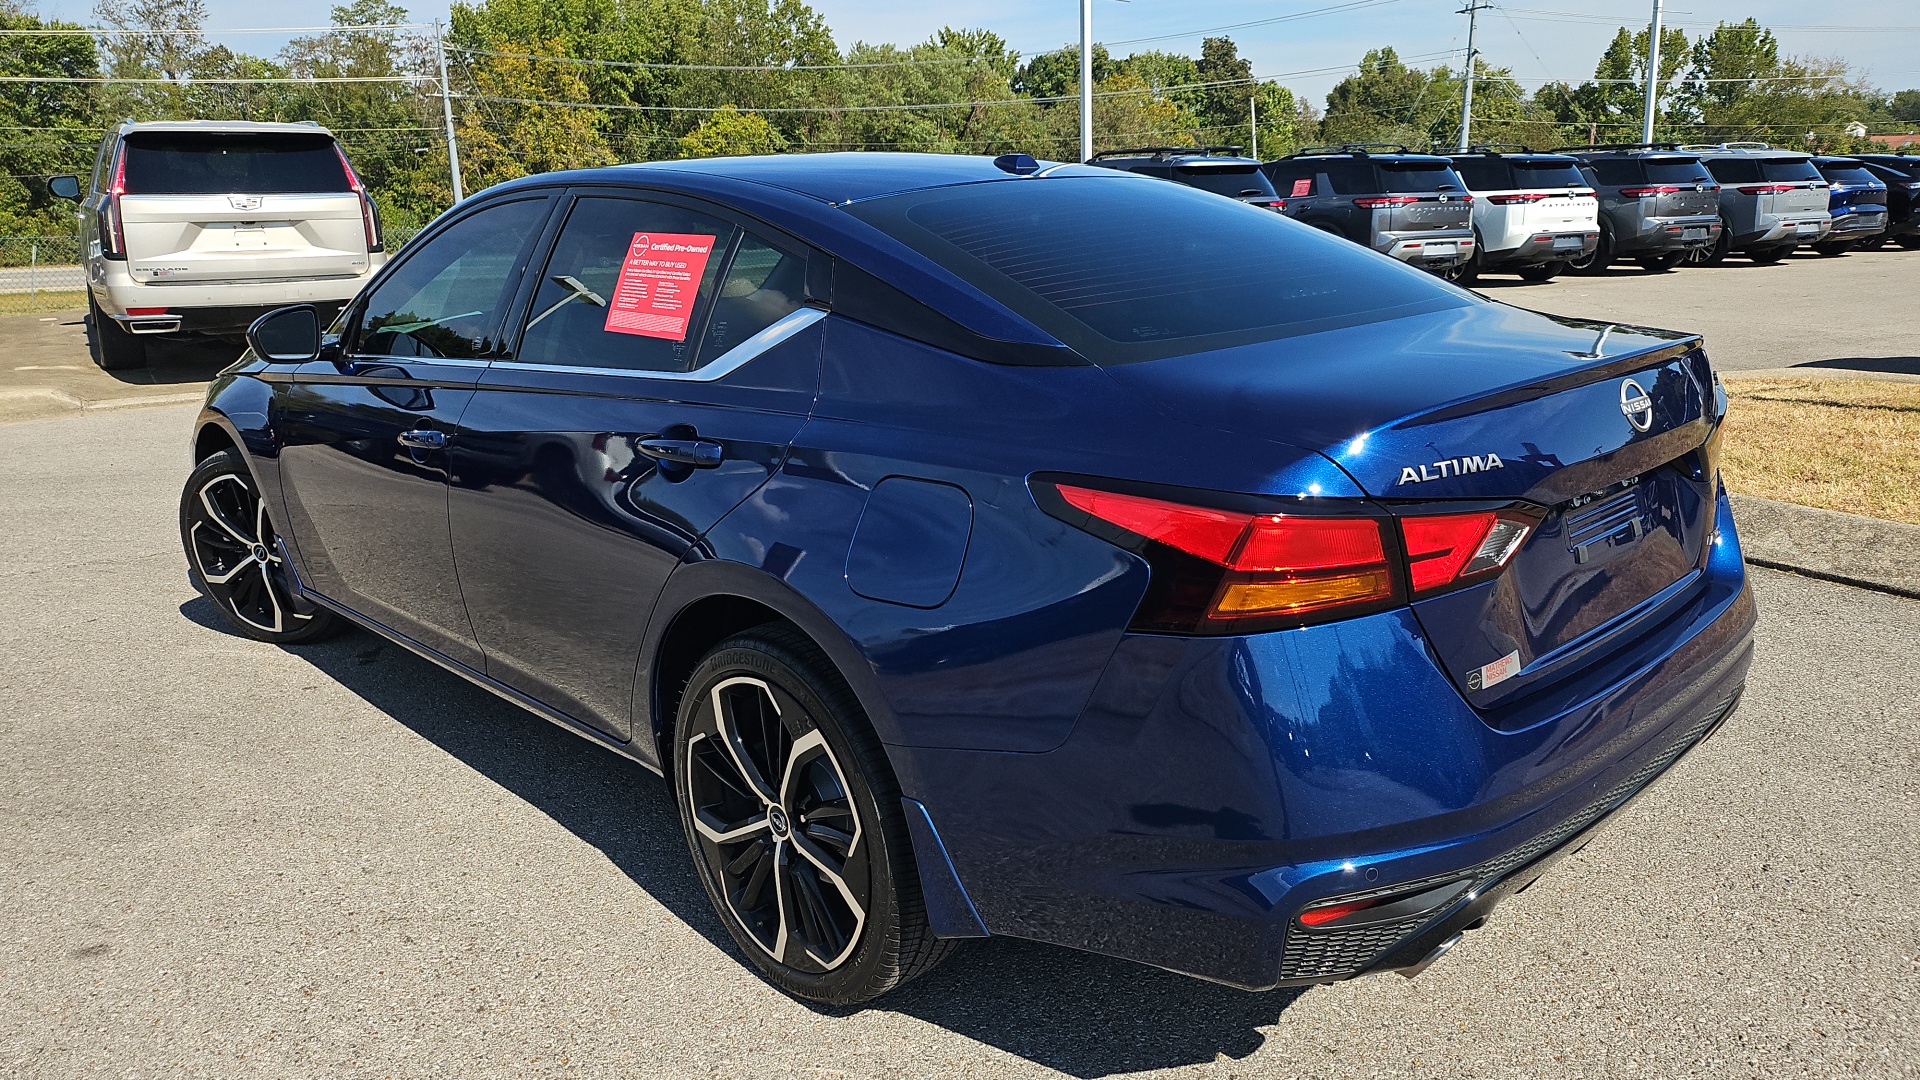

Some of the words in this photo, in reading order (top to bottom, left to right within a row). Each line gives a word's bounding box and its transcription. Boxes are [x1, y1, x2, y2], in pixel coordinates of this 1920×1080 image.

[650, 243, 675, 251] Certified
[675, 244, 709, 253] Pre-Owned
[1397, 453, 1504, 485] ALTIMA
[710, 652, 776, 674] BRIDGESTONE
[1485, 656, 1513, 673] MATHEWS
[1486, 667, 1507, 681] NISSAN
